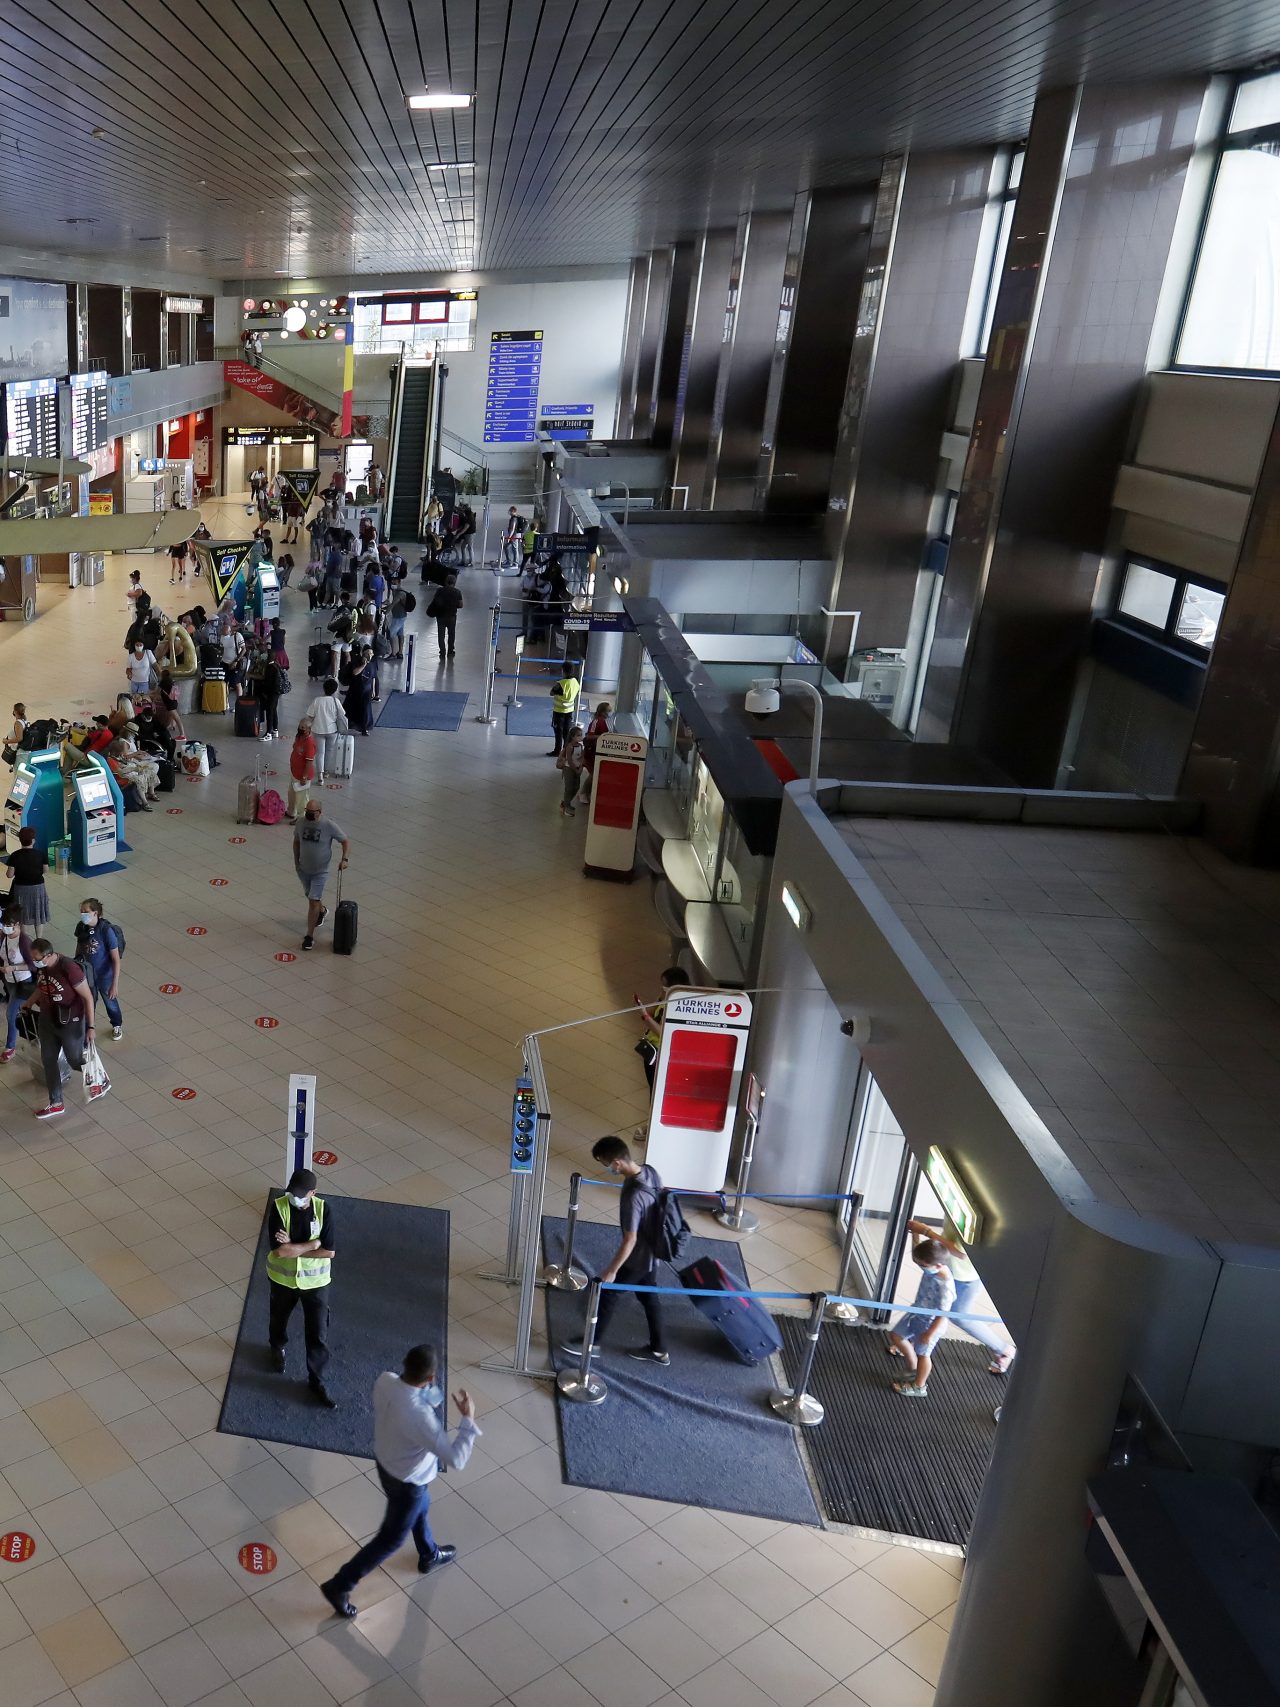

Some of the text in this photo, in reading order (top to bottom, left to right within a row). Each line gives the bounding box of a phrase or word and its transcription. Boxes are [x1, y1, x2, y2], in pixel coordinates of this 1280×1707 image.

[675, 1005, 720, 1015] AIRLINES
[677, 999, 721, 1009] TURKISH
[11, 1535, 21, 1559] STOP
[252, 1546, 263, 1570] STOP
